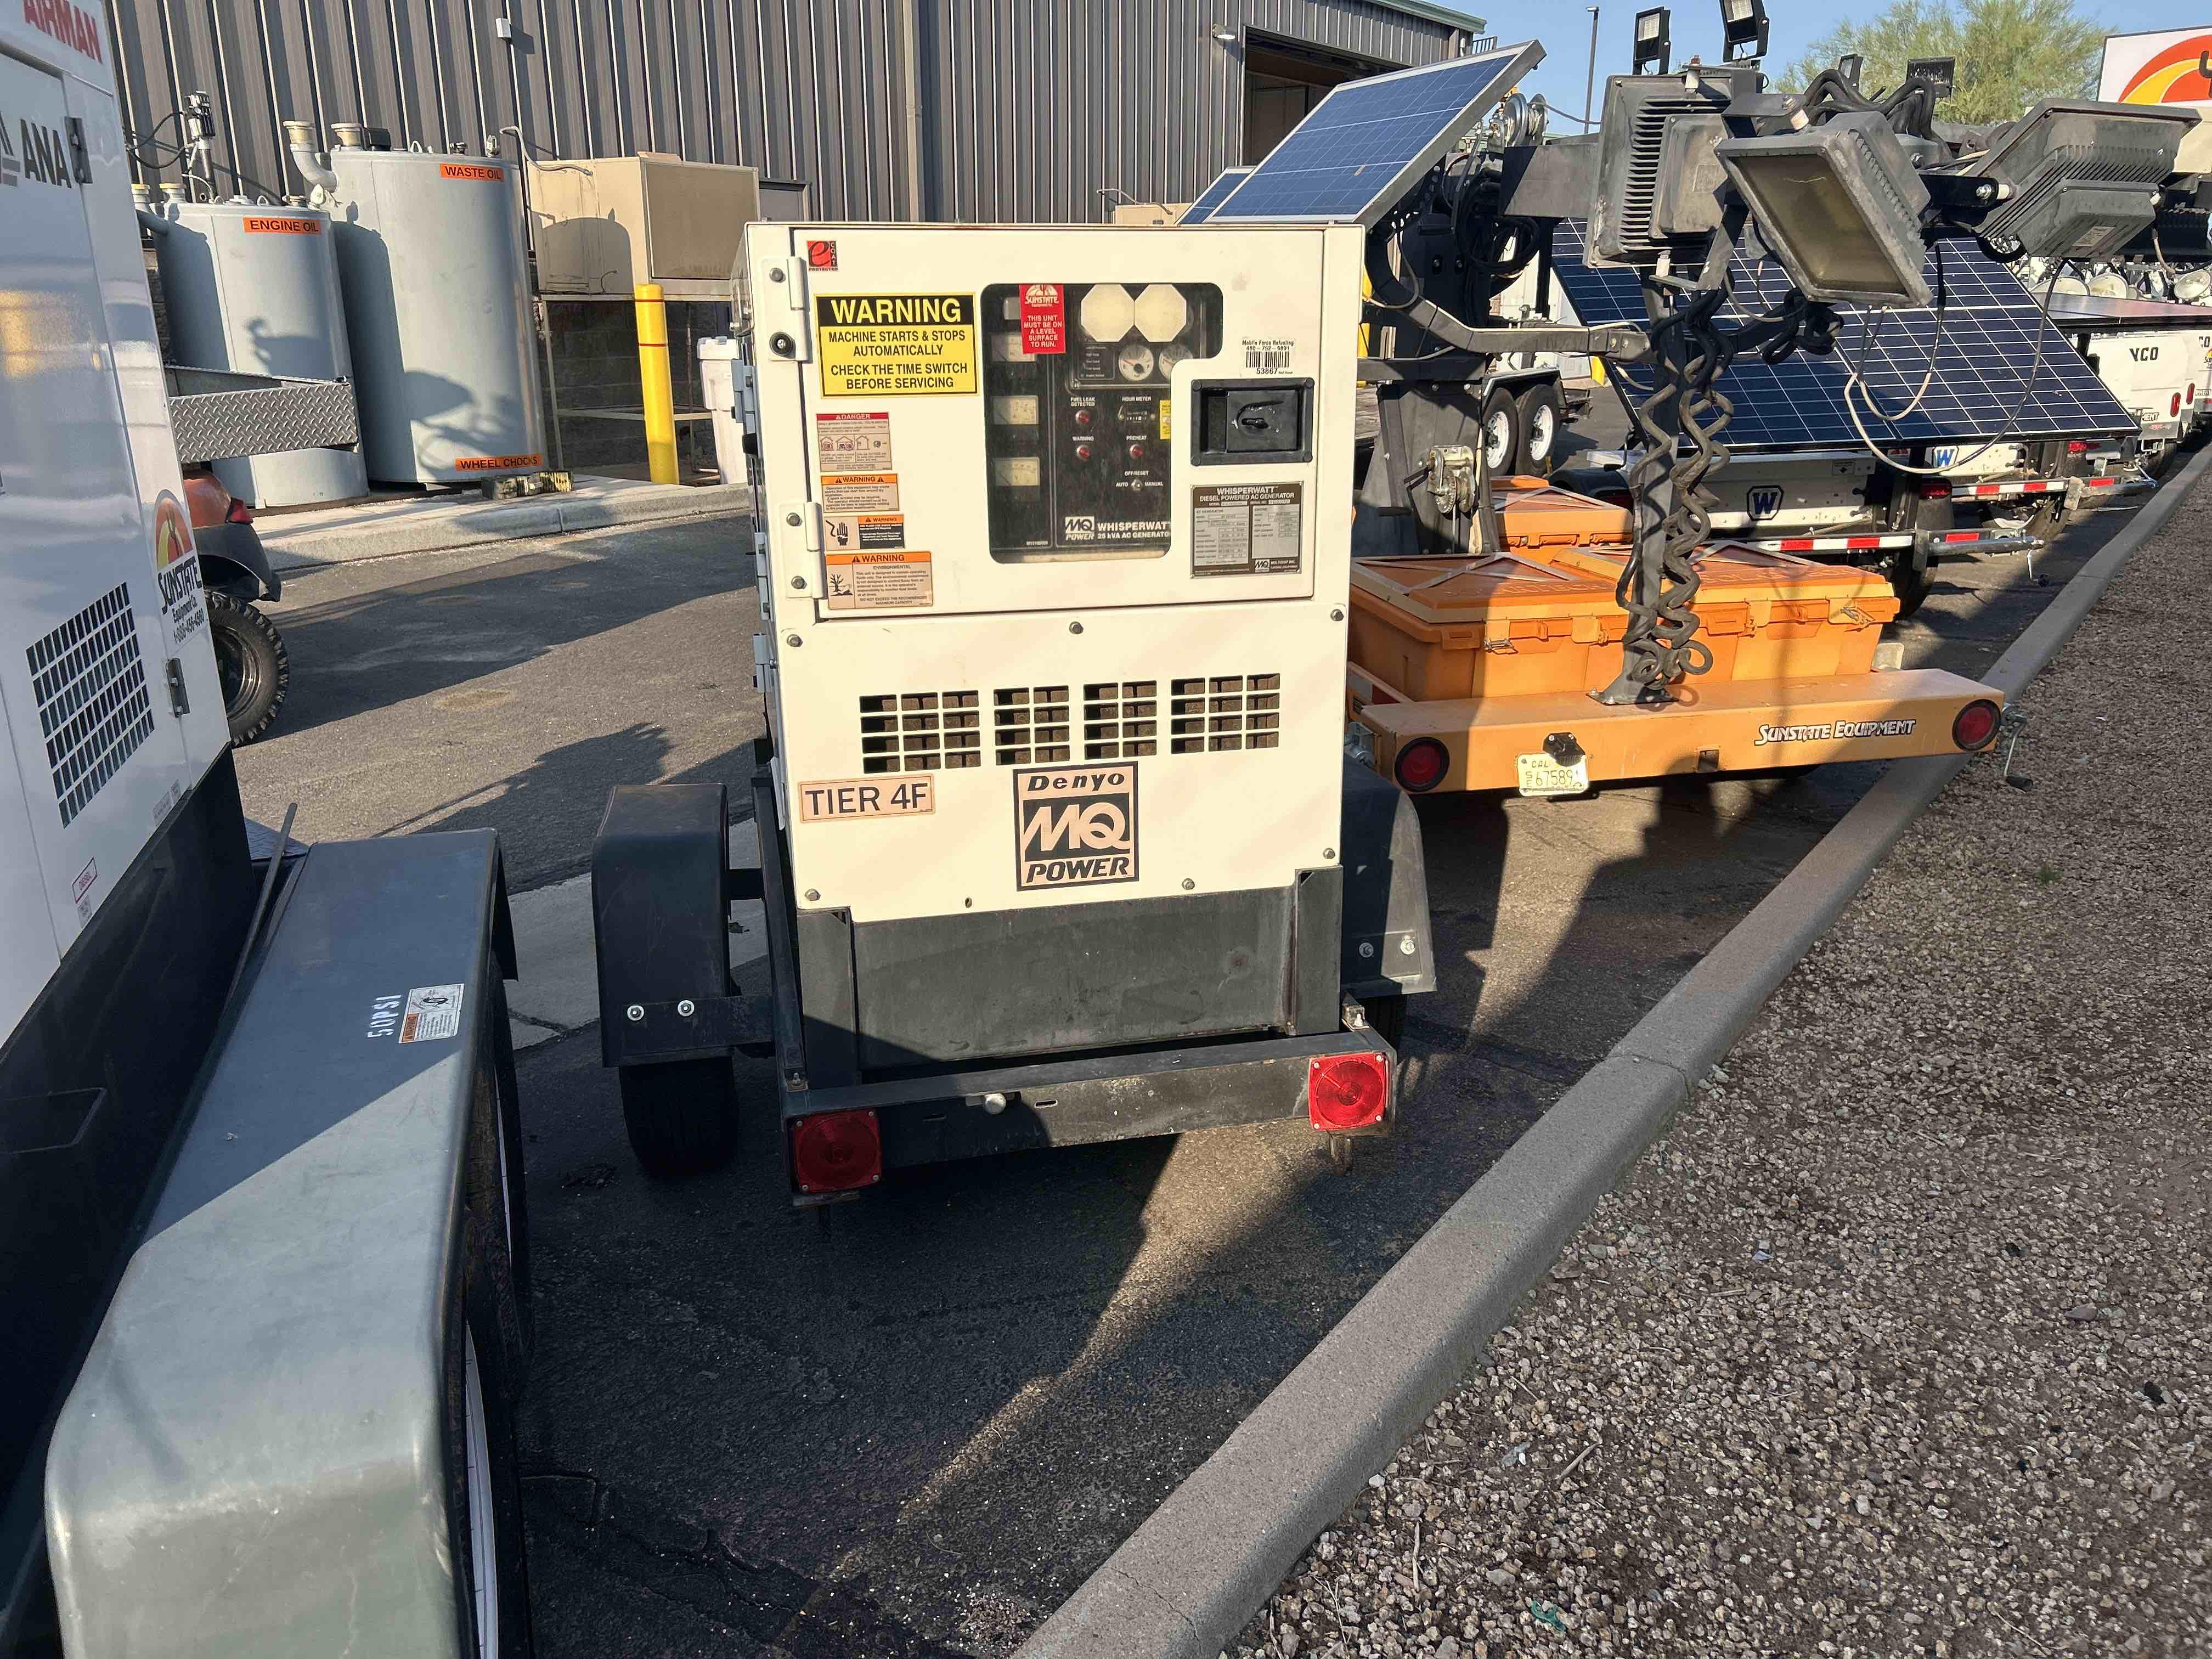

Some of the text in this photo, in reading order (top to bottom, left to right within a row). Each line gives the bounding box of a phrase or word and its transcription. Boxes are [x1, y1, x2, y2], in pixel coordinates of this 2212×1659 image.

[20, 119, 72, 188] ANA
[445, 167, 501, 179] WASTE OIL
[250, 220, 319, 233] ENGINE OIL
[831, 298, 960, 324] WARNING
[829, 330, 966, 343] MACHINE STARTS & STOPS
[854, 345, 943, 357] AUTOMATICALLY
[831, 363, 967, 375] CHECK THE TIME SWITCH
[847, 377, 953, 390] BEFORE SERVICING
[461, 456, 538, 469] WHEEL CHOCKS
[1217, 486, 1274, 495] WHISPERWATT
[1752, 492, 1777, 515] W
[1065, 518, 1094, 532] MQ
[861, 554, 905, 562] WARNING
[1754, 719, 1916, 746] SUNSTATE EQUIPMENT
[1028, 772, 1126, 792] Denyo
[1536, 770, 1573, 786] 67589
[805, 782, 928, 815] TIER 4F
[1024, 802, 1131, 851] MQ
[1026, 857, 1130, 883] POWER
